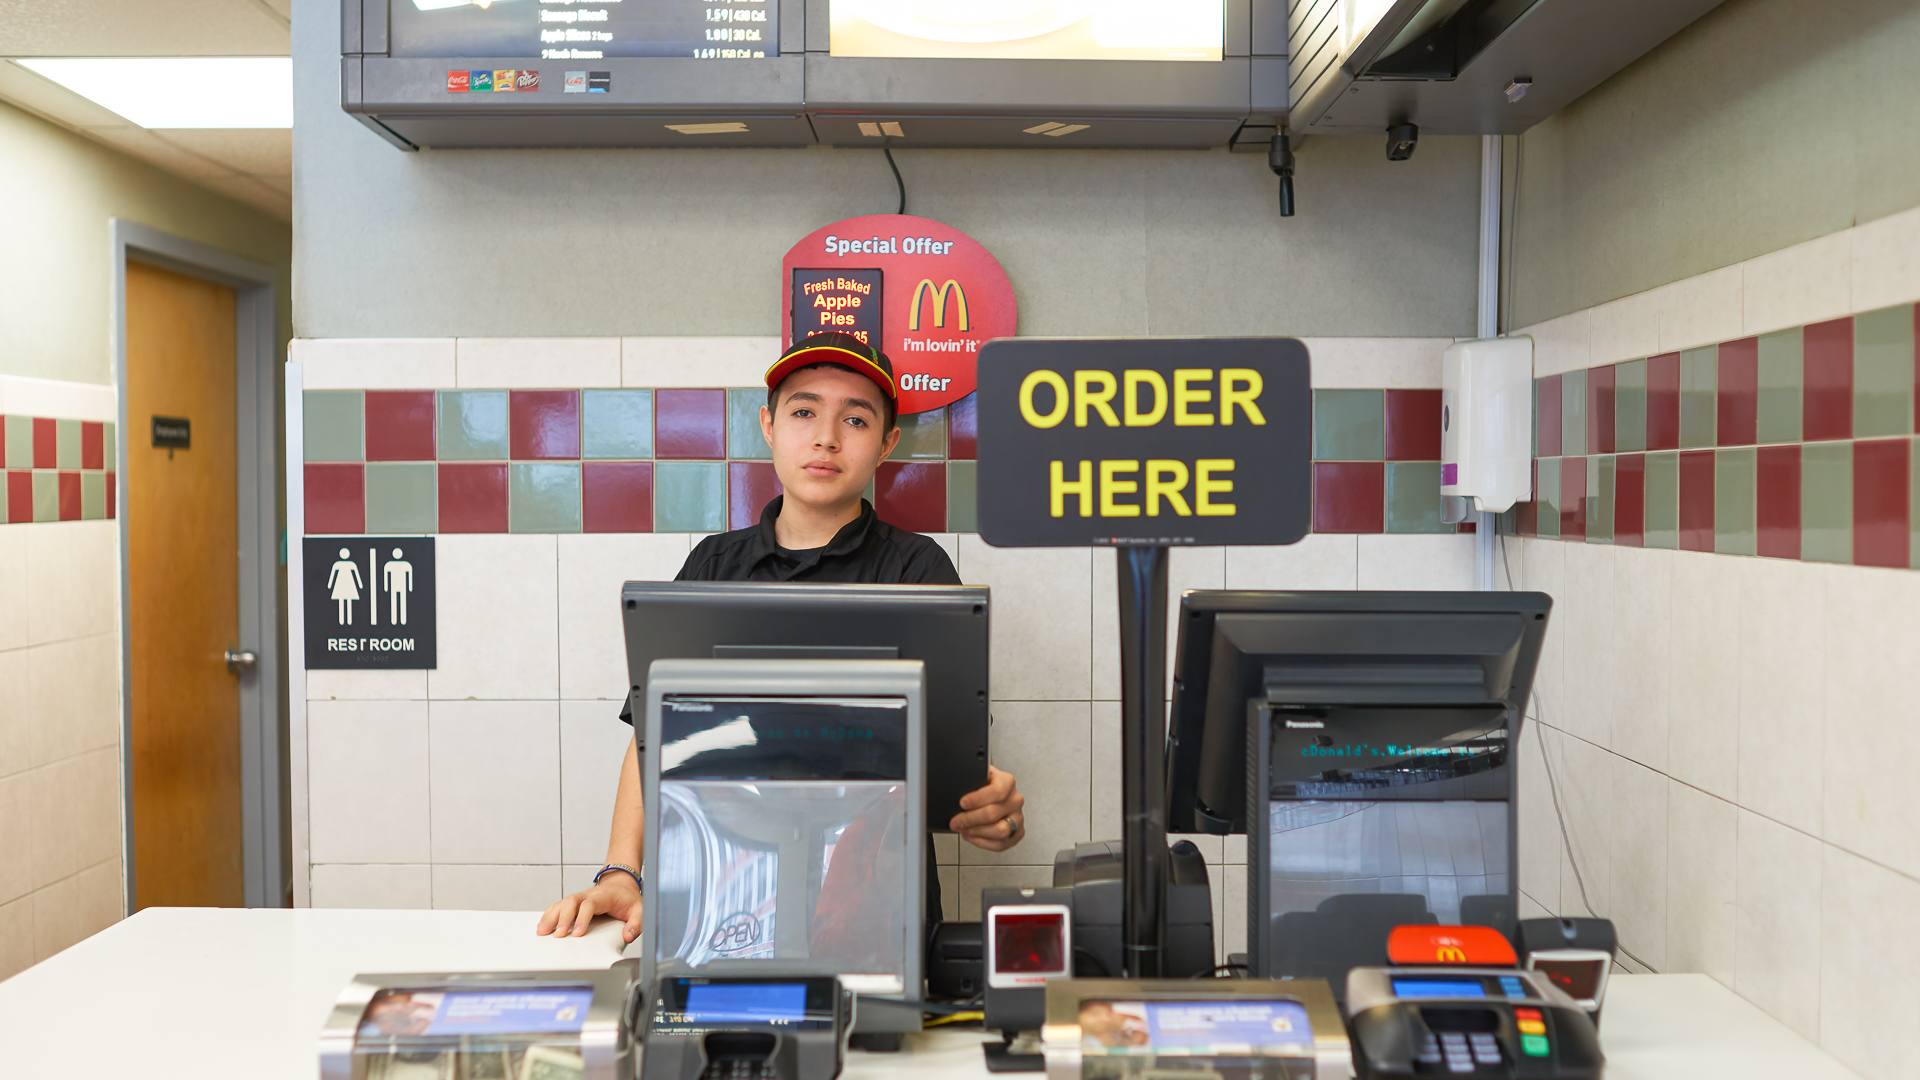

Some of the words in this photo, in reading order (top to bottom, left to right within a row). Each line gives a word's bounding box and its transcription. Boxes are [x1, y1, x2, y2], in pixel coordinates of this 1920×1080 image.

[824, 235, 898, 257] Special
[902, 236, 955, 255] Offer
[803, 278, 835, 295] Fresh
[837, 277, 871, 295] Baked
[813, 294, 862, 310] Apple
[820, 311, 855, 325] Pies
[965, 339, 977, 352] it
[900, 373, 951, 392] Offer
[1018, 368, 1267, 429] ORDER
[1050, 458, 1237, 518] HERE
[1286, 720, 1325, 728] Panasonic
